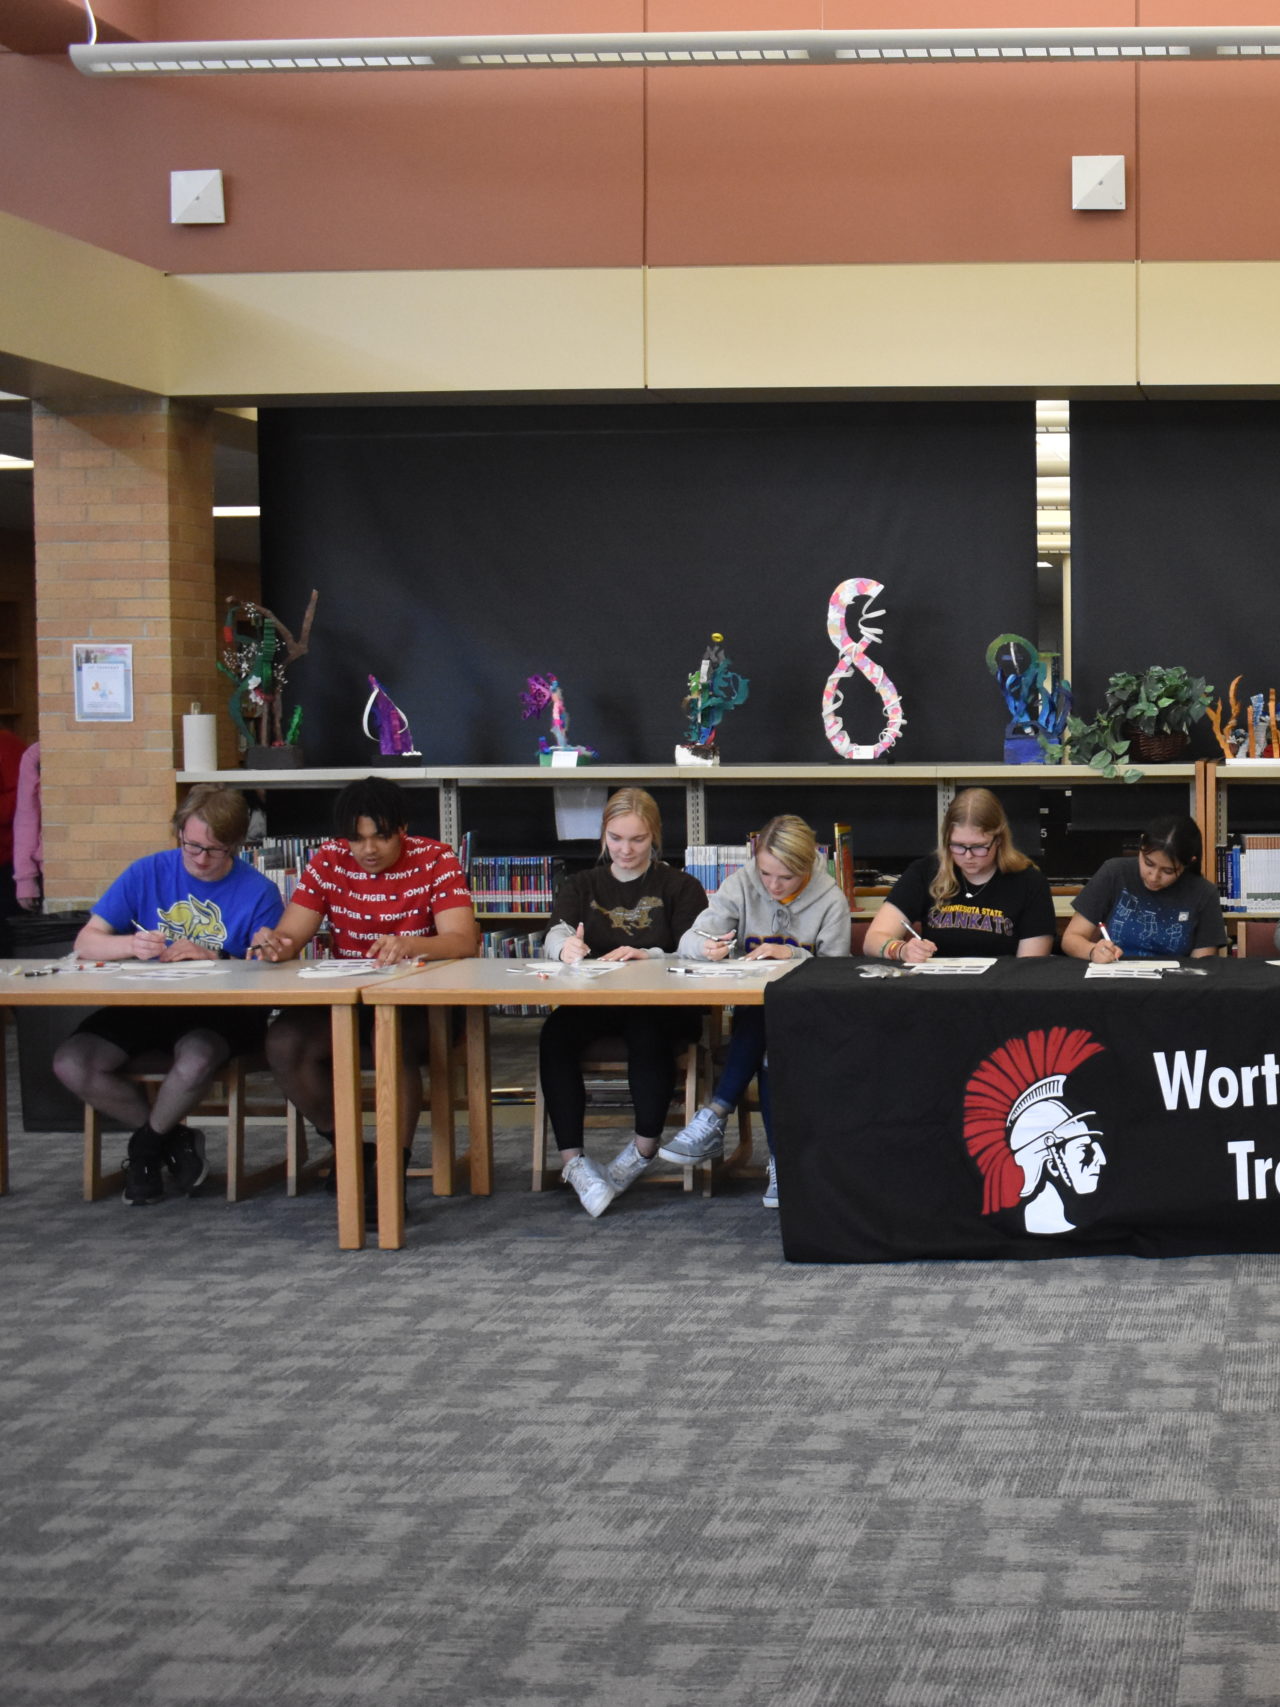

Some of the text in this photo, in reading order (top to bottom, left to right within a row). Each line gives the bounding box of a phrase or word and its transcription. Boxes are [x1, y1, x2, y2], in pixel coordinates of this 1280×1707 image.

[334, 865, 368, 880] HILFIGER
[384, 869, 413, 880] TOMMY
[349, 890, 387, 902] HILFIGER
[380, 909, 412, 921] TOMMY
[941, 904, 1003, 917] MINNESOTA STATE
